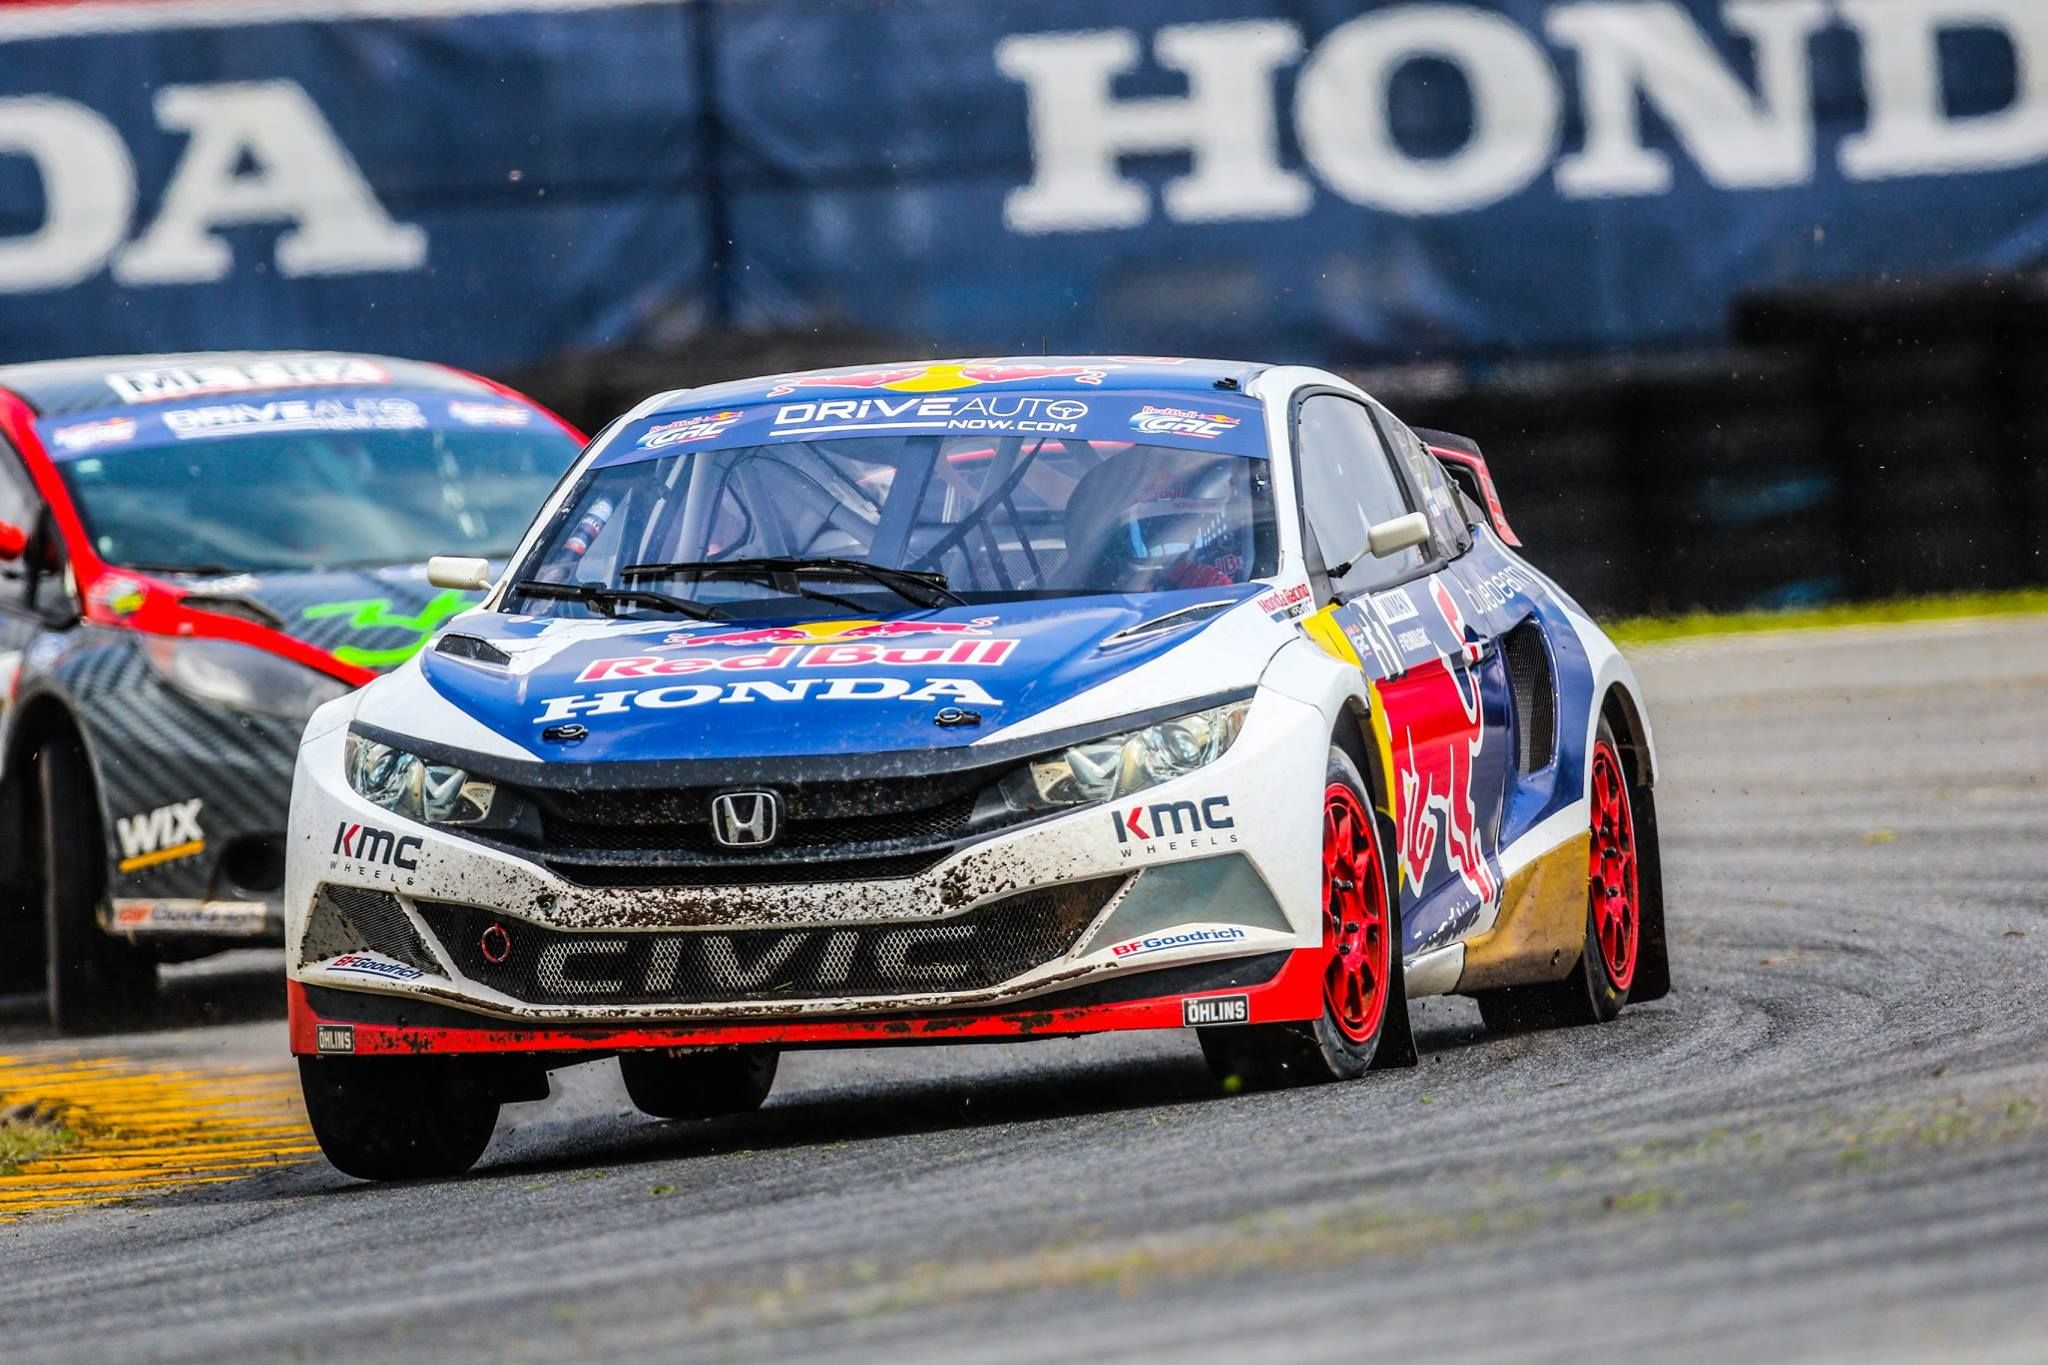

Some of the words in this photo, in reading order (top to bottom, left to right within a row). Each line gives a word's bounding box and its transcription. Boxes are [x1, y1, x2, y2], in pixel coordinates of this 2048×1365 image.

[947, 419, 1078, 433] NOW.COM
[574, 647, 799, 683] Red
[798, 639, 1021, 667] Bull
[533, 677, 1003, 724] HONDA
[117, 798, 203, 858] WIX
[1112, 928, 1245, 957] BFGoodrich
[331, 955, 424, 980] BFGoodrich
[536, 926, 978, 994] CIVIC
[1187, 1000, 1246, 1024] ÖHLINS
[318, 1027, 352, 1051] ÖHLINS
